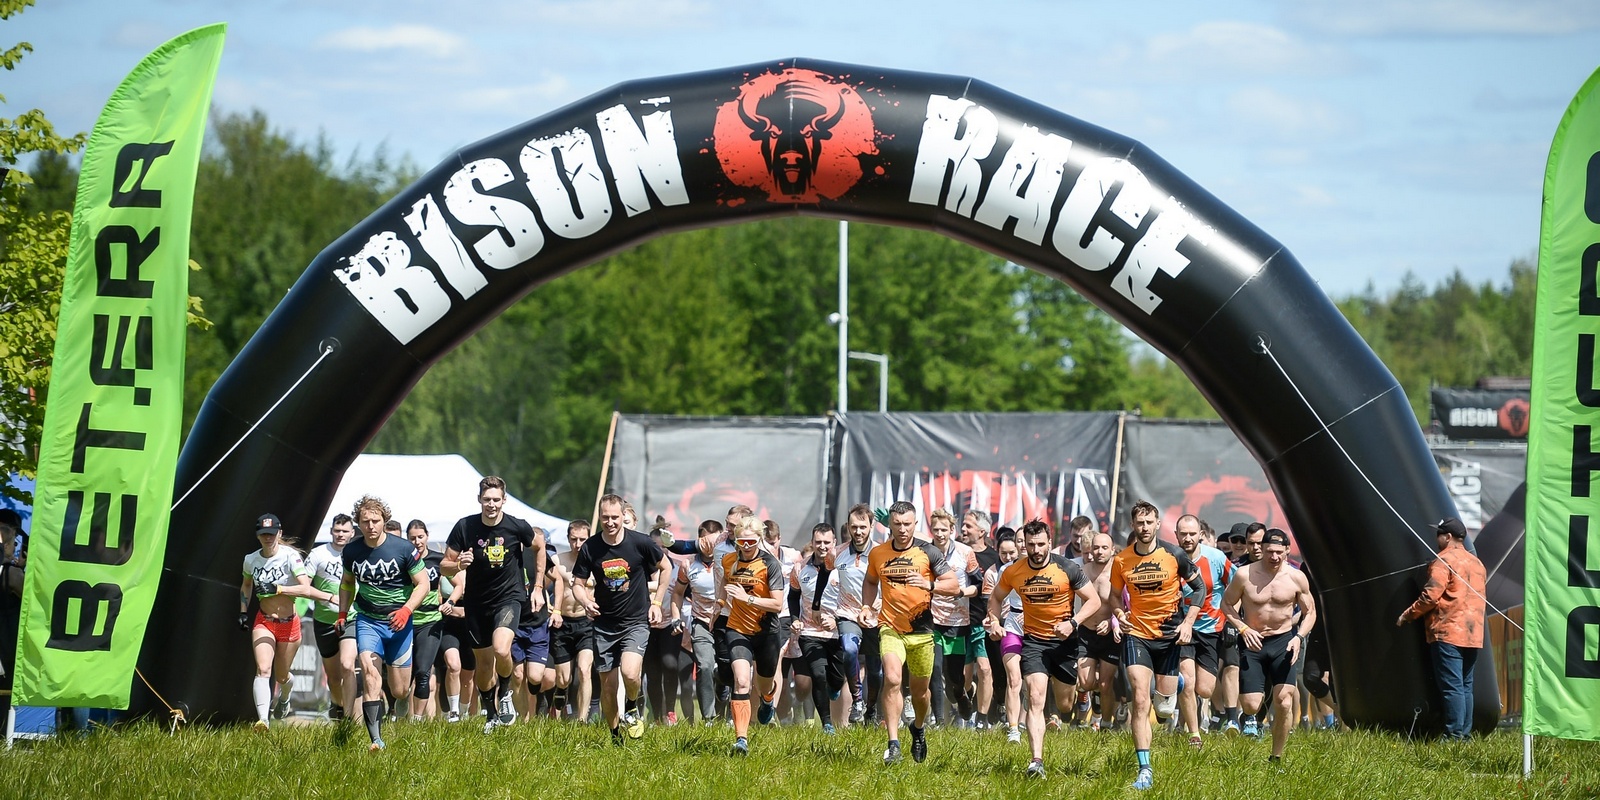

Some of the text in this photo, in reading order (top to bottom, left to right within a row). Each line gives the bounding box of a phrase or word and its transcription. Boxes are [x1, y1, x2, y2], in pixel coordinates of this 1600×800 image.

[333, 94, 1218, 345] BISON RACE
[1449, 407, 1498, 428] BISON
